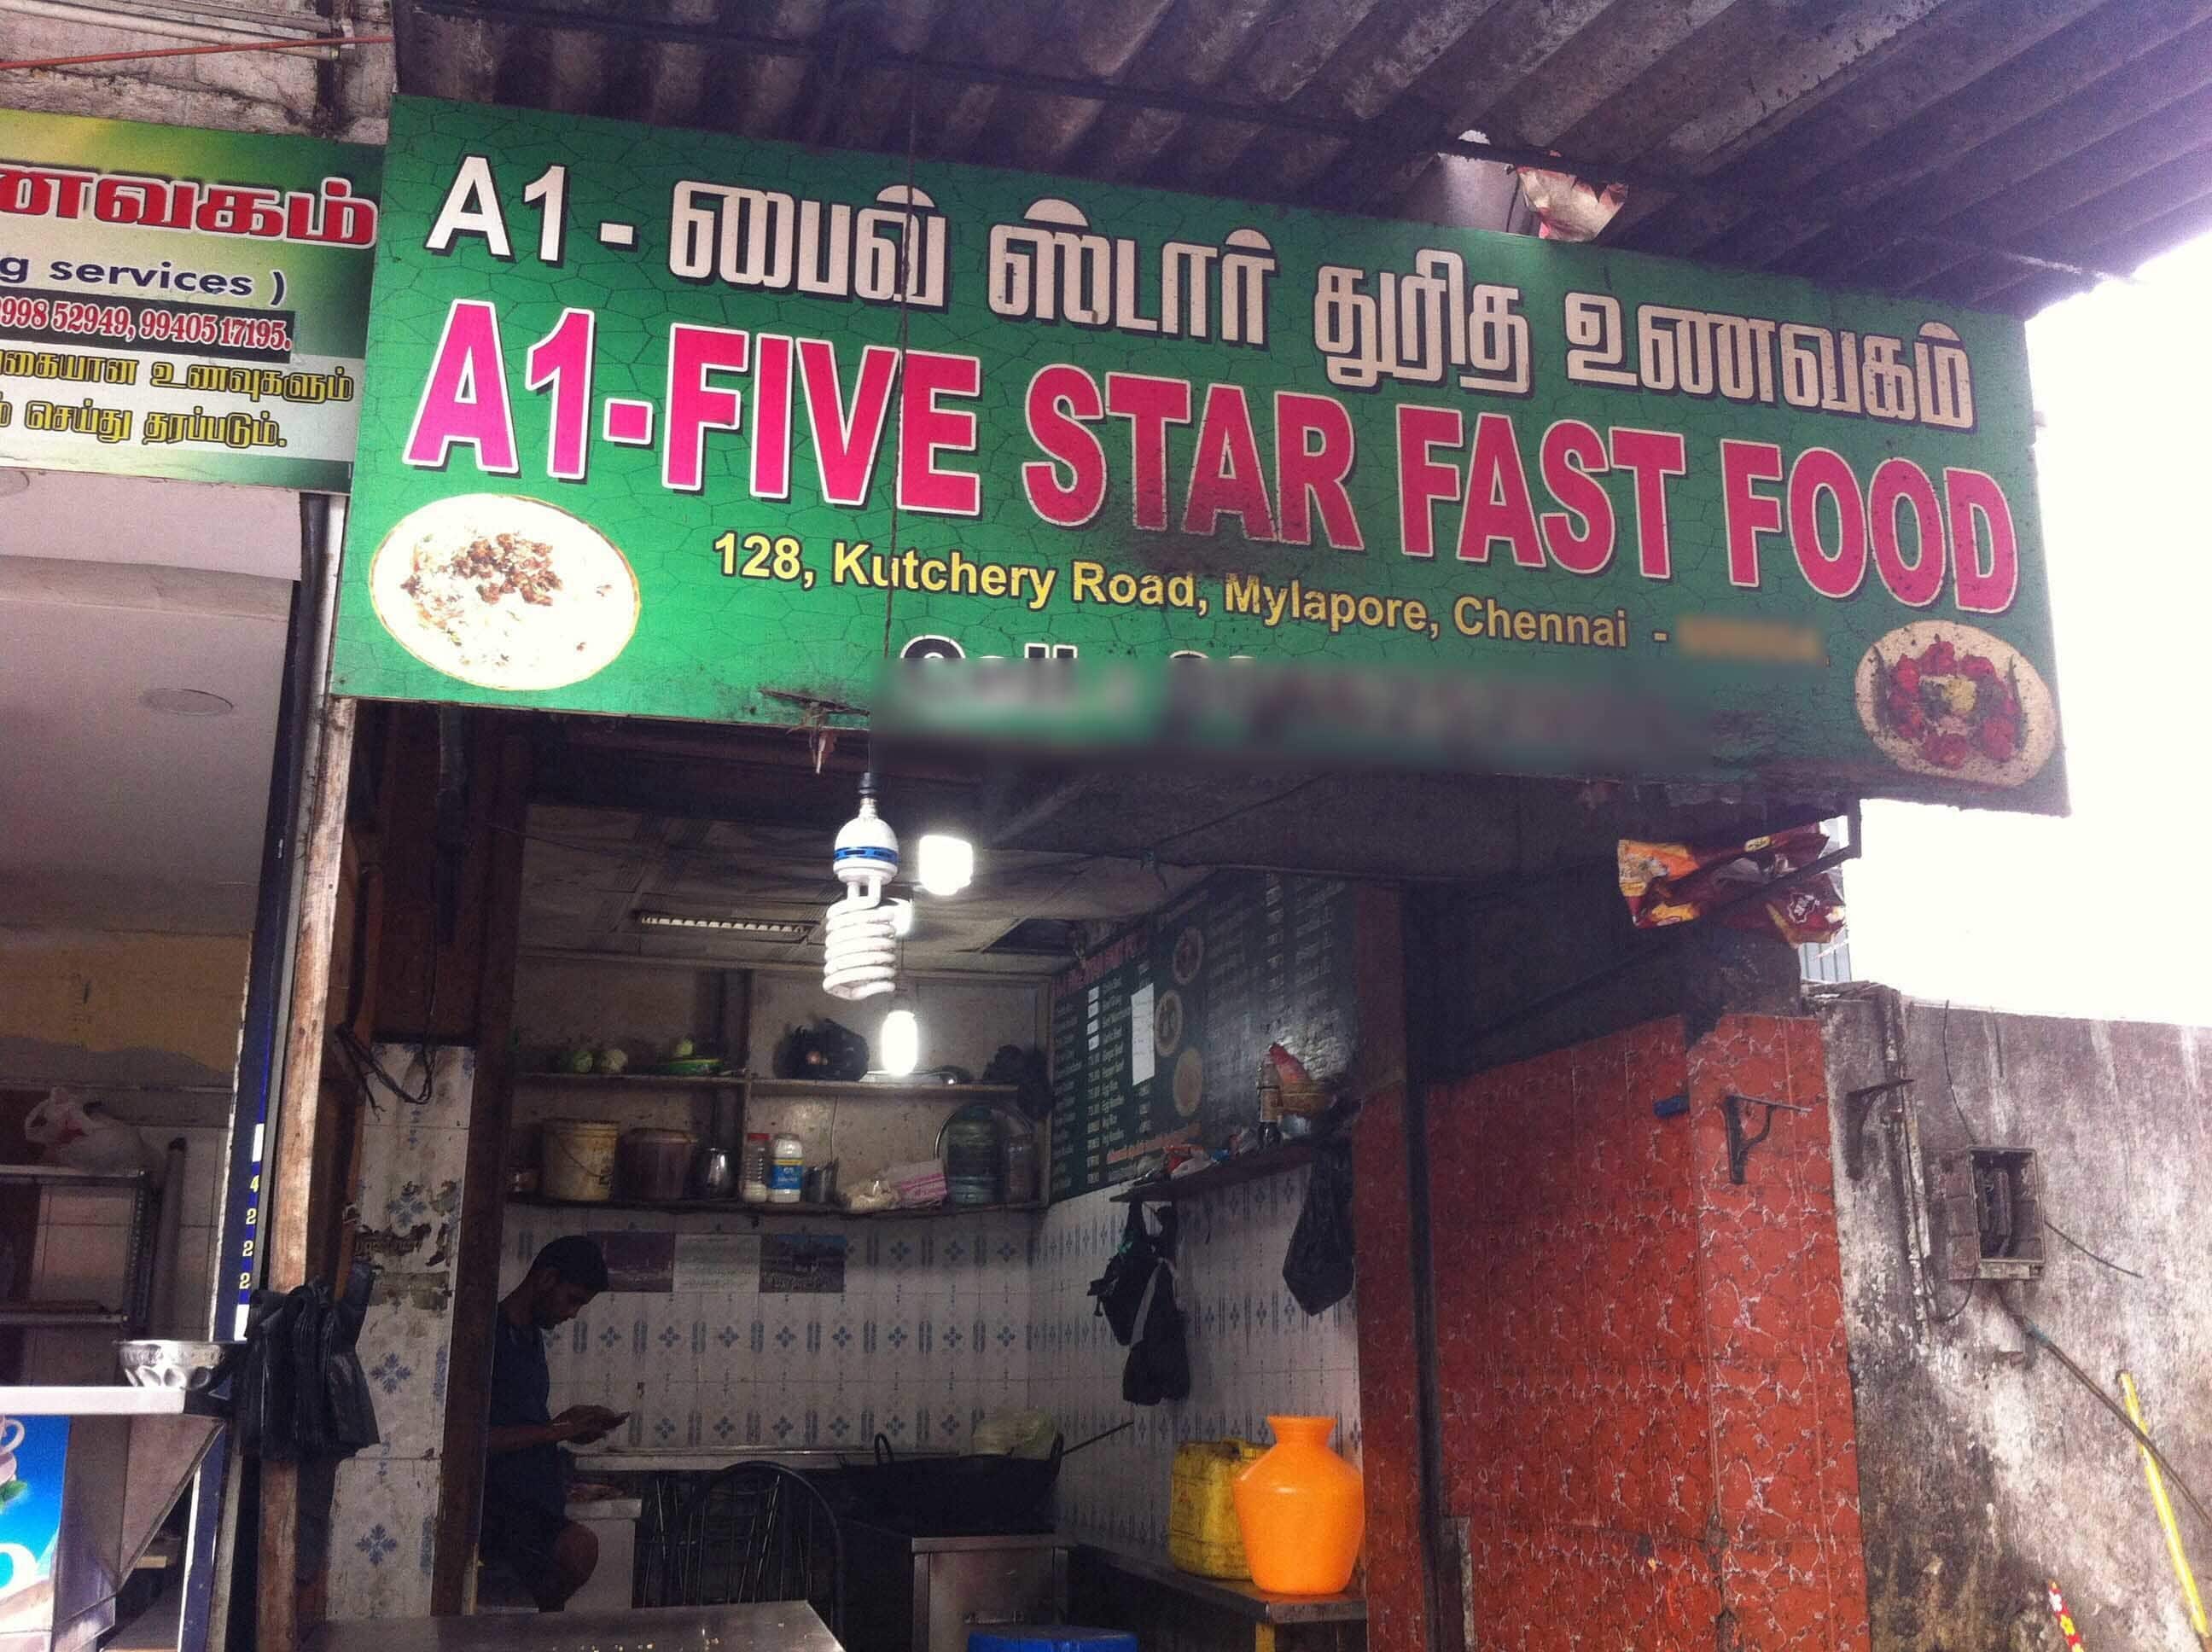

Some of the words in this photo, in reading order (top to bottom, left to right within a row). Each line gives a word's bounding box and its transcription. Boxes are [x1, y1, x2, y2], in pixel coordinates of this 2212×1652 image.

[49, 260, 253, 296] services
[426, 156, 565, 261] A1
[988, 199, 1276, 345] ஸ்டார்
[1314, 249, 1531, 394] துரித
[1564, 292, 1974, 429] உணவகம்
[53, 300, 135, 342] 52949,
[140, 308, 218, 343] 99405
[220, 317, 293, 352] 17195.
[0, 348, 140, 386] கையான
[25, 398, 133, 444] செய்து
[1022, 364, 1365, 552] STAR
[1396, 404, 1686, 579] FAST
[1720, 439, 2019, 614] FOOD
[713, 532, 815, 589] 128,
[833, 541, 1057, 609] Kutchery
[1073, 561, 1208, 616] Road,
[1225, 573, 1439, 639] Mylapore,
[1453, 596, 1627, 648] Chennai
